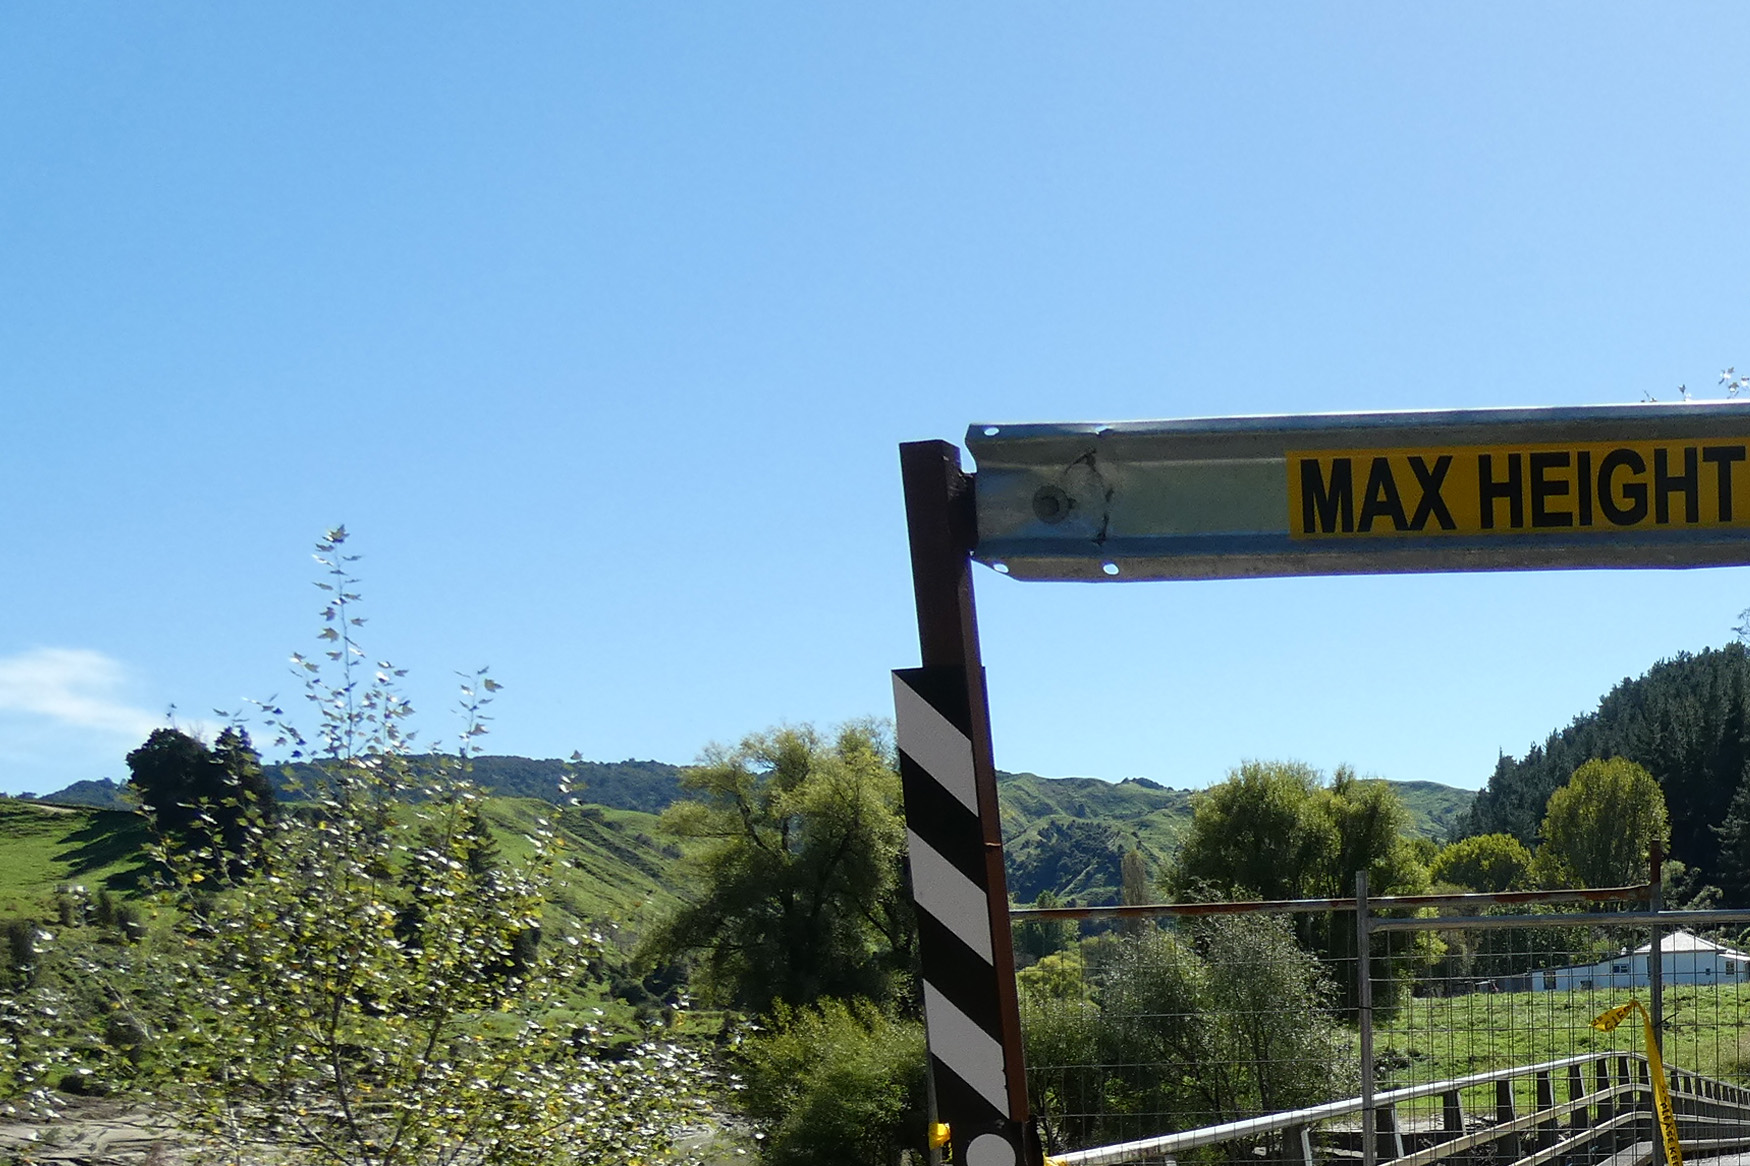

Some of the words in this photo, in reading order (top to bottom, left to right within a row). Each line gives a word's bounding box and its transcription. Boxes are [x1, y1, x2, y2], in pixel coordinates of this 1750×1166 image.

[1302, 455, 1456, 533] MAX
[1478, 446, 1745, 529] HEIGHT
[1659, 1102, 1675, 1144] PLEASE
